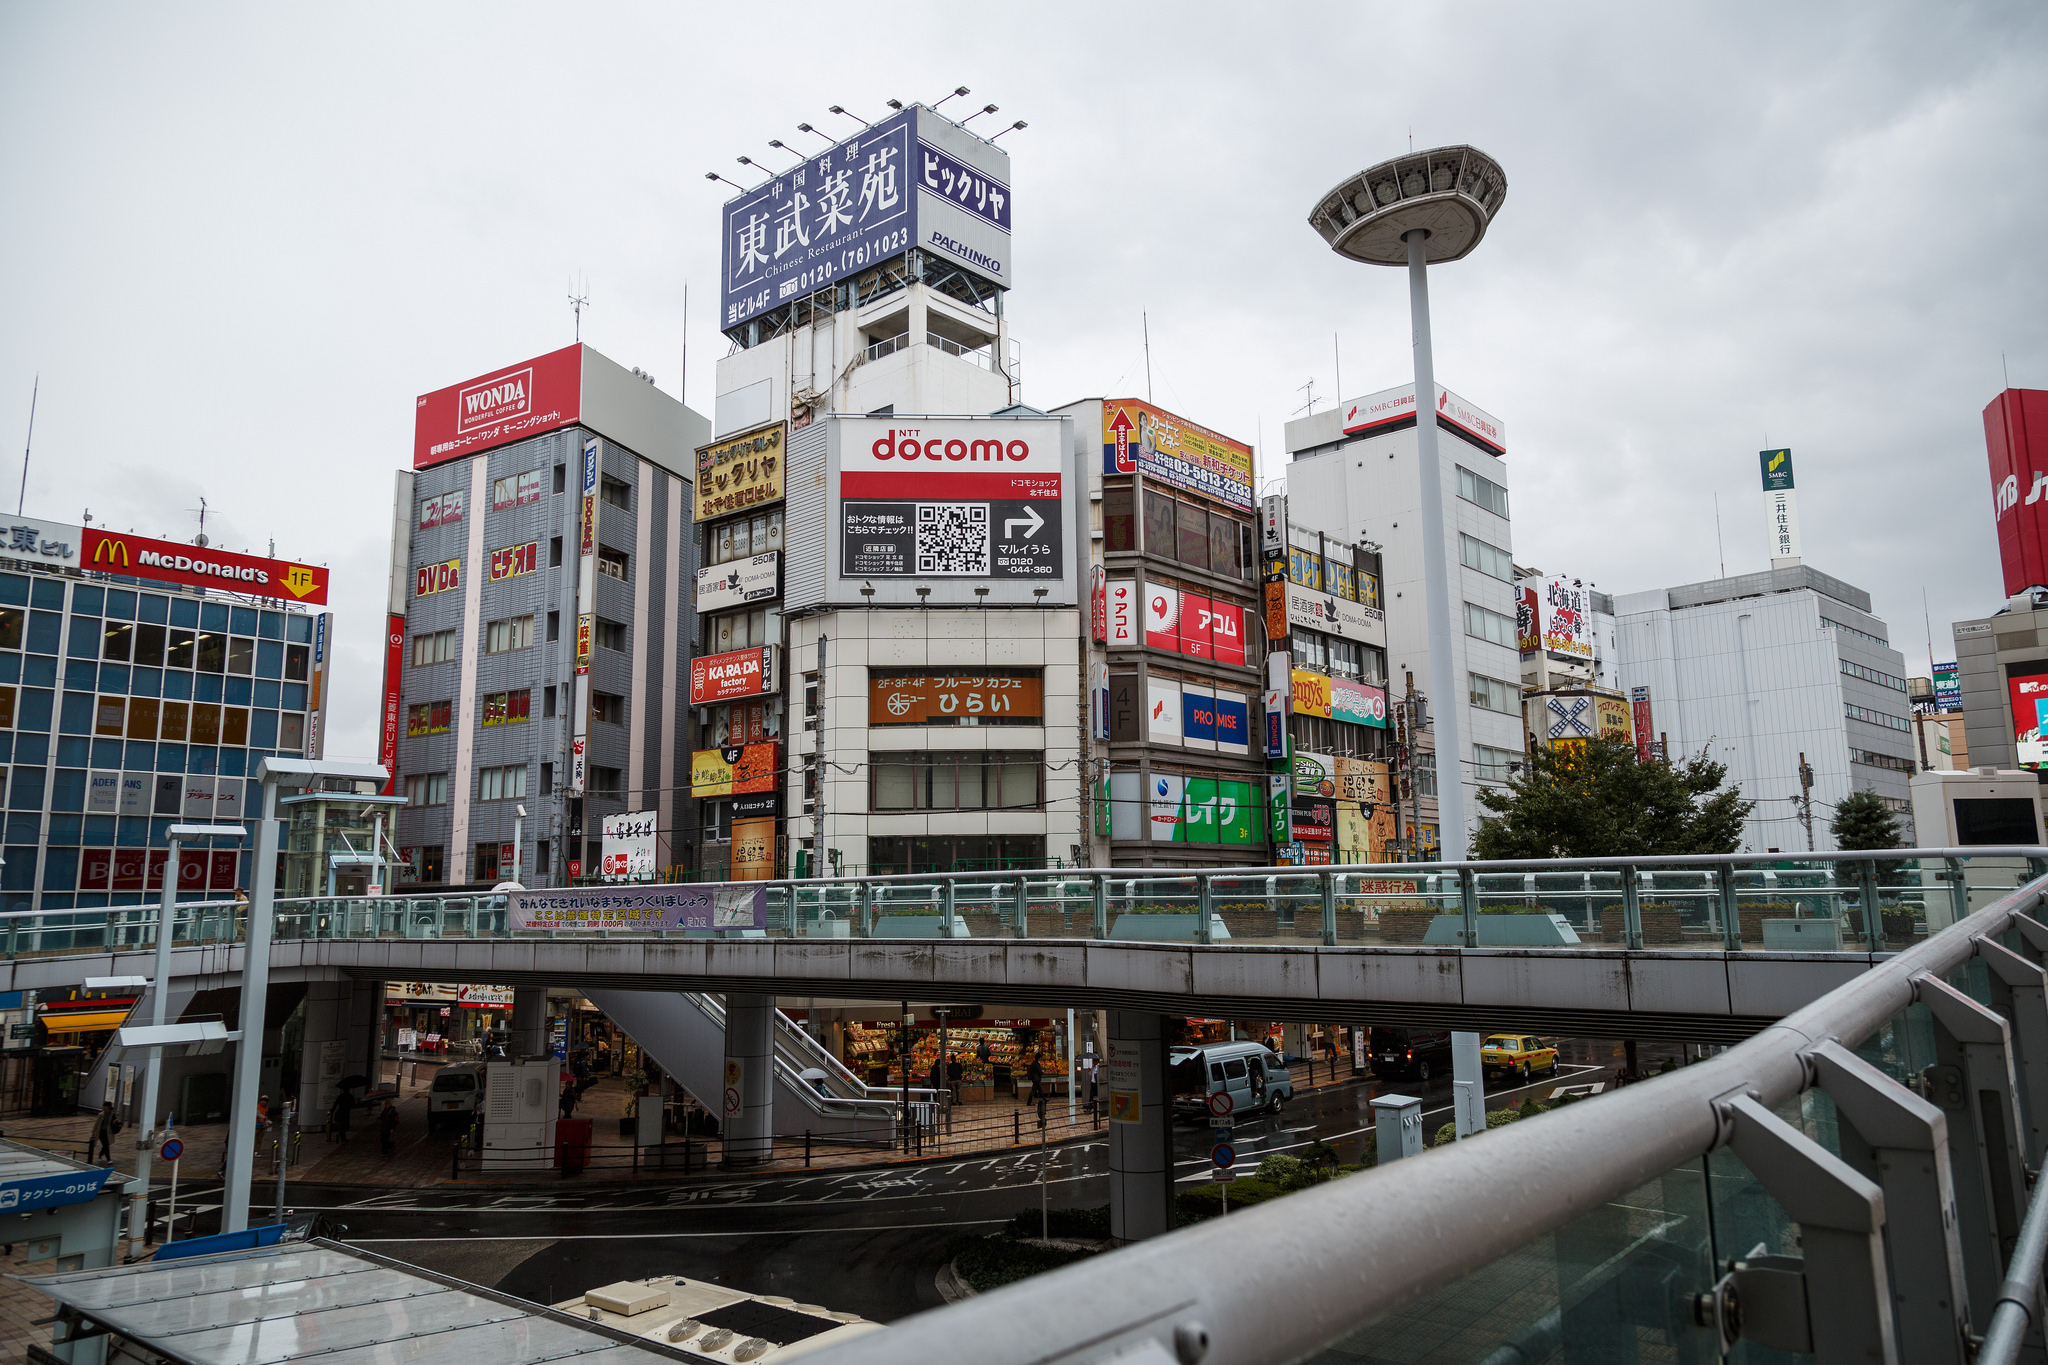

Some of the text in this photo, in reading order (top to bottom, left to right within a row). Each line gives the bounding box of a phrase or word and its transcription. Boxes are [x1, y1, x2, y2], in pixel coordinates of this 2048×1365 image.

[771, 141, 859, 200] 中国料理
[924, 150, 1005, 220] ビックリヤ
[735, 147, 899, 279] 東武菜苑
[764, 227, 865, 280] Chinese Restaurant
[801, 227, 908, 289] 0120-(76)1023
[932, 230, 1001, 273] PACHINKO
[728, 288, 771, 325] 当ビル4F
[466, 378, 525, 415] WONDA
[464, 403, 516, 425] WONDERFUL COFFEE
[1457, 407, 1497, 439] SMBC日興証券
[899, 429, 921, 437] NTT
[872, 429, 1029, 462] docomo
[1117, 425, 1126, 464] 富士そば入る
[699, 455, 777, 496] ビックリヤ
[1203, 454, 1250, 483] 新和チケット
[1010, 479, 1058, 487] ドコモショップ
[1174, 459, 1252, 499] 03-5813-2333
[702, 482, 777, 515] 北千住西口ビル
[1029, 488, 1059, 497] 北千住店
[846, 515, 904, 524] おトクな情報は
[1774, 492, 1792, 555] 三井住友銀行
[847, 526, 913, 535] こちらでチェック!!
[998, 544, 1051, 555] マルイうら
[138, 549, 269, 585] McDonald's
[1007, 566, 1053, 574] -044-360
[1010, 558, 1034, 566] 0120
[291, 571, 310, 586] 1F
[416, 562, 459, 597] DVD&
[698, 568, 709, 579] 5F
[744, 570, 775, 584] DOMA-DOMA
[1547, 584, 1582, 613] 北海道
[1115, 602, 1129, 639] アコム
[1198, 608, 1237, 637] アコム
[1190, 642, 1201, 654] 5F
[762, 647, 772, 691] 当ビル4F
[720, 676, 747, 688] factory
[933, 677, 1022, 689] フルーツ カフェ
[901, 693, 926, 703] ニュー
[938, 692, 1010, 714] ひらい
[1116, 687, 1131, 730] 4F
[1193, 708, 1238, 729] PROMISE
[1324, 705, 1331, 714] 1F
[732, 709, 743, 739] 骨盤
[750, 706, 761, 737] 整体
[1605, 713, 1624, 728] 募集中
[384, 692, 398, 779] 三菱東京UFJ銀
[1271, 715, 1279, 747] PROMISE
[726, 749, 738, 762] 4F
[1336, 759, 1345, 769] 2F
[162, 781, 176, 791] 4F
[185, 792, 236, 801] アデランス
[765, 799, 775, 808] 2F
[1185, 793, 1236, 826] レイク
[1275, 799, 1285, 831] レイク
[1239, 827, 1248, 838] 3F
[139, 861, 203, 881] ECO
[216, 864, 230, 874] 3F
[1361, 880, 1416, 894] 迷惑行為
[519, 894, 709, 910] みんなできれいなまちをつくりましょう
[535, 909, 665, 921] ここは禁煙特定区域です
[687, 916, 707, 928] 足立区
[876, 1021, 896, 1029] Fresh
[993, 1018, 1031, 1027] Fruits Gift
[22, 1181, 99, 1201] タクシーのりば
